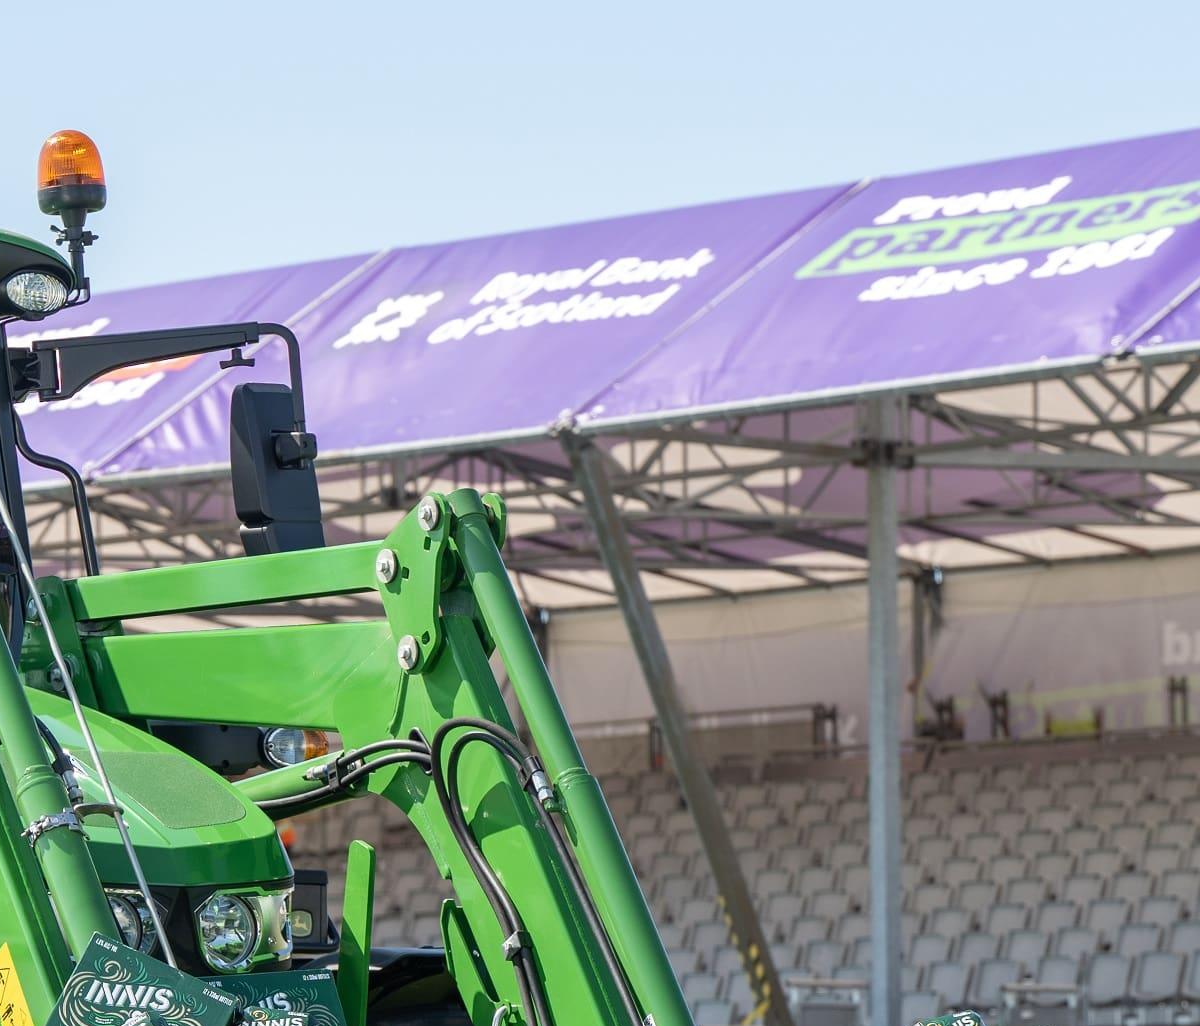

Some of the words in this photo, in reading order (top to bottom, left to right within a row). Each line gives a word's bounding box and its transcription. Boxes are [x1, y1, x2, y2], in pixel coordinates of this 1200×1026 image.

[874, 176, 1071, 225] Proud
[471, 259, 606, 301] Royal
[591, 249, 713, 286] Bank
[858, 258, 1028, 301] since
[428, 308, 482, 343] of
[474, 284, 680, 335] Scotland
[84, 980, 175, 1011] INNIS
